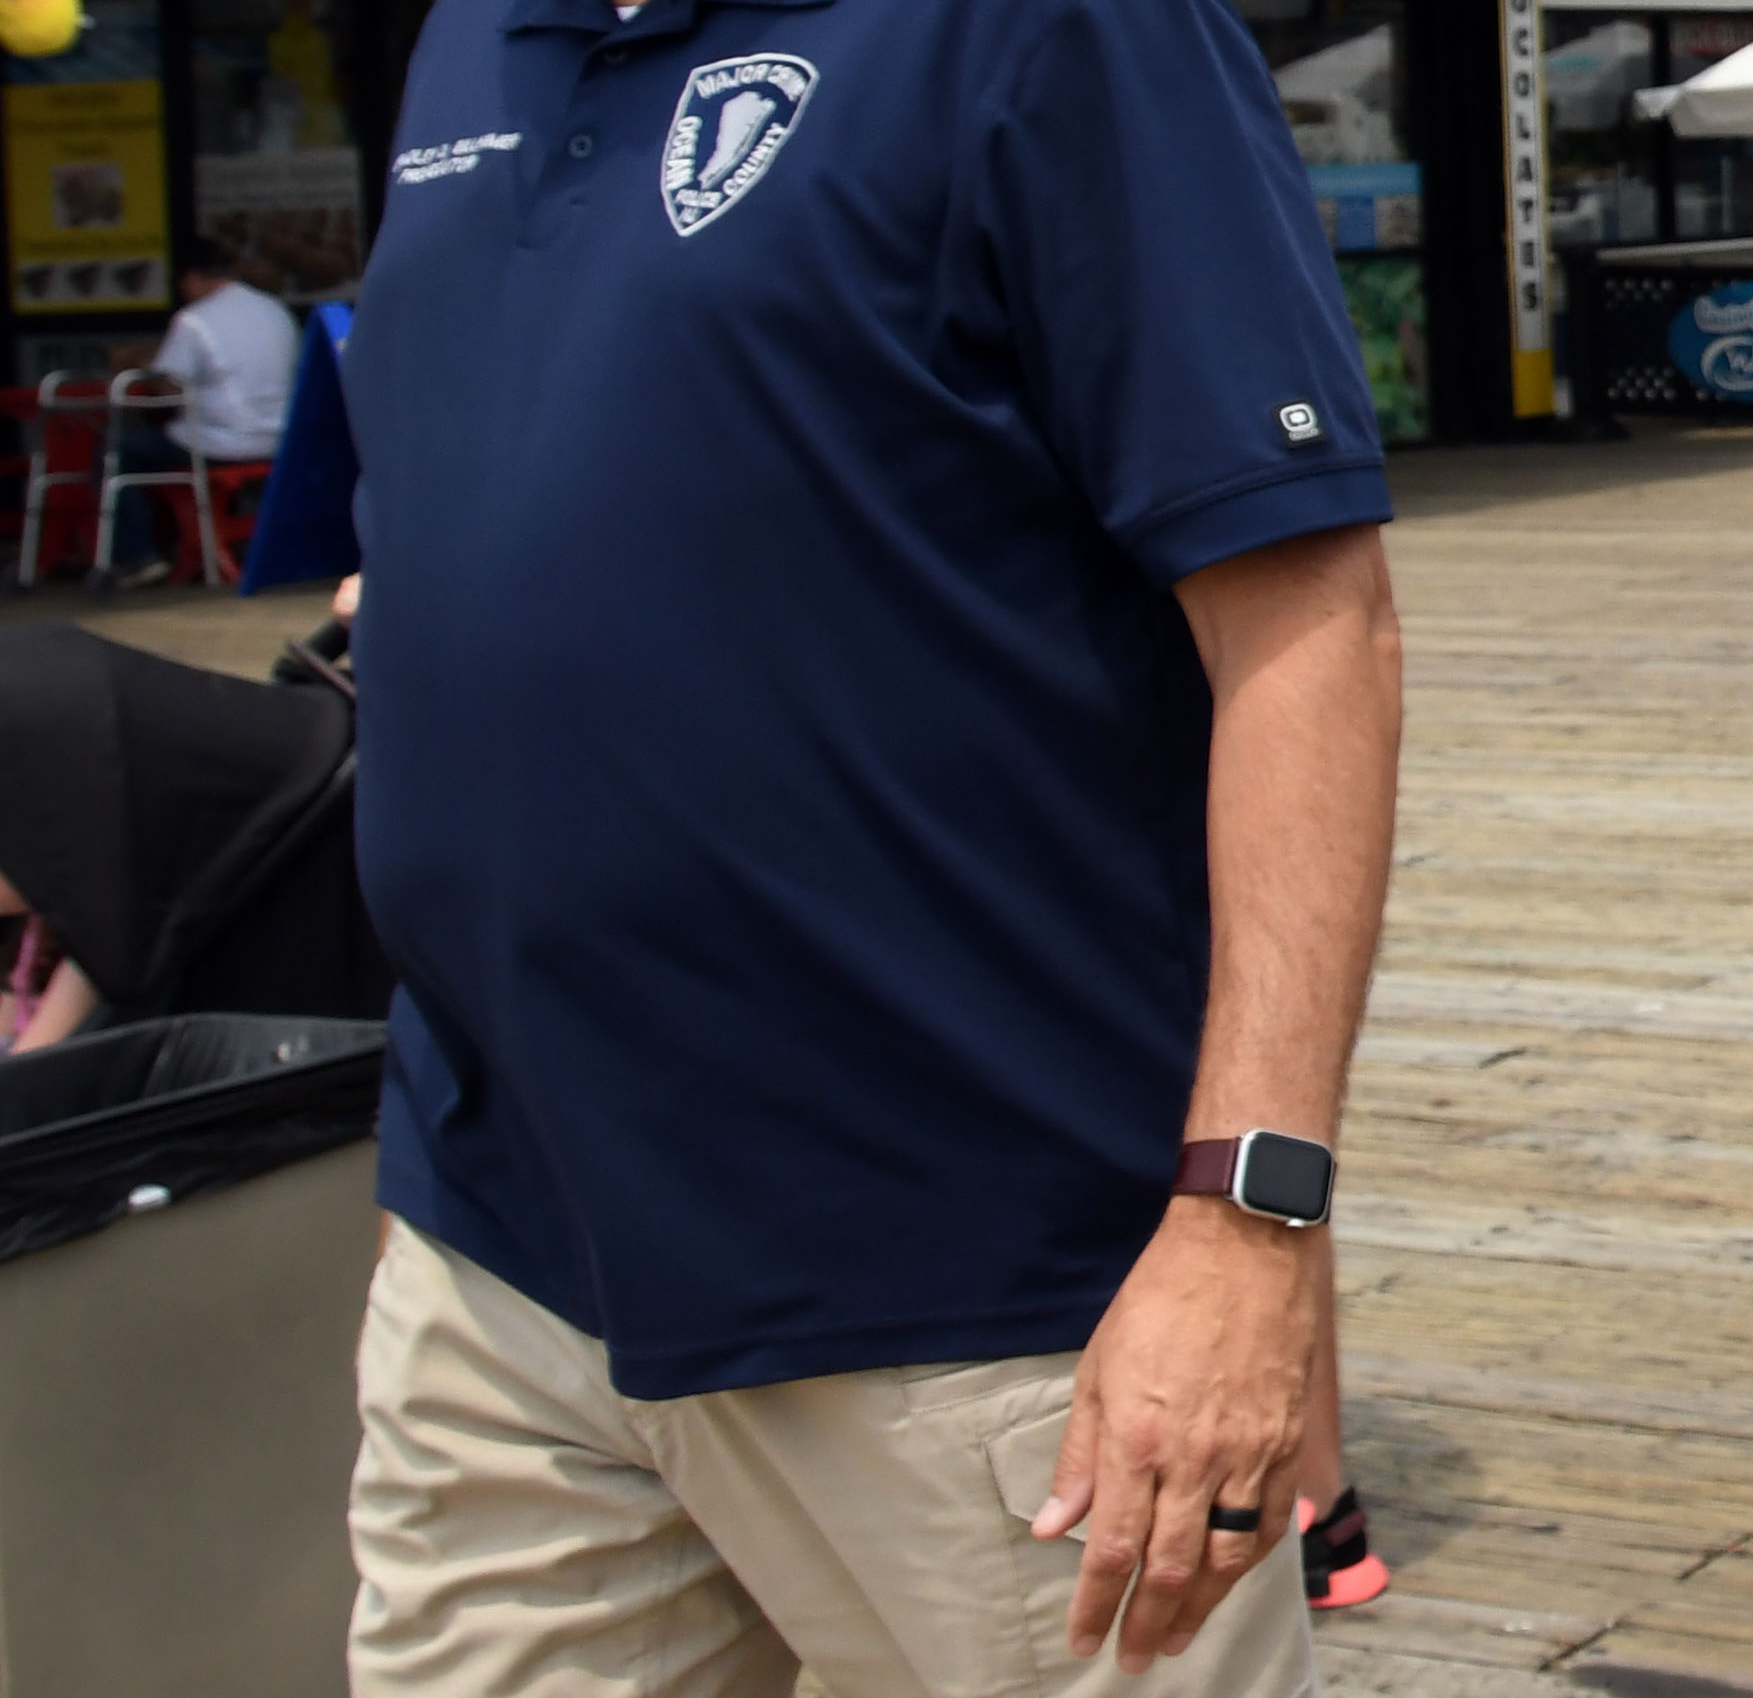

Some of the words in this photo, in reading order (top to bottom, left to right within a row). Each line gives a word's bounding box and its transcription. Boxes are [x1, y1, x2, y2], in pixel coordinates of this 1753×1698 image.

[695, 62, 770, 99] MAJOR
[665, 115, 703, 191] OCEAN
[722, 122, 786, 197] COUNTY
